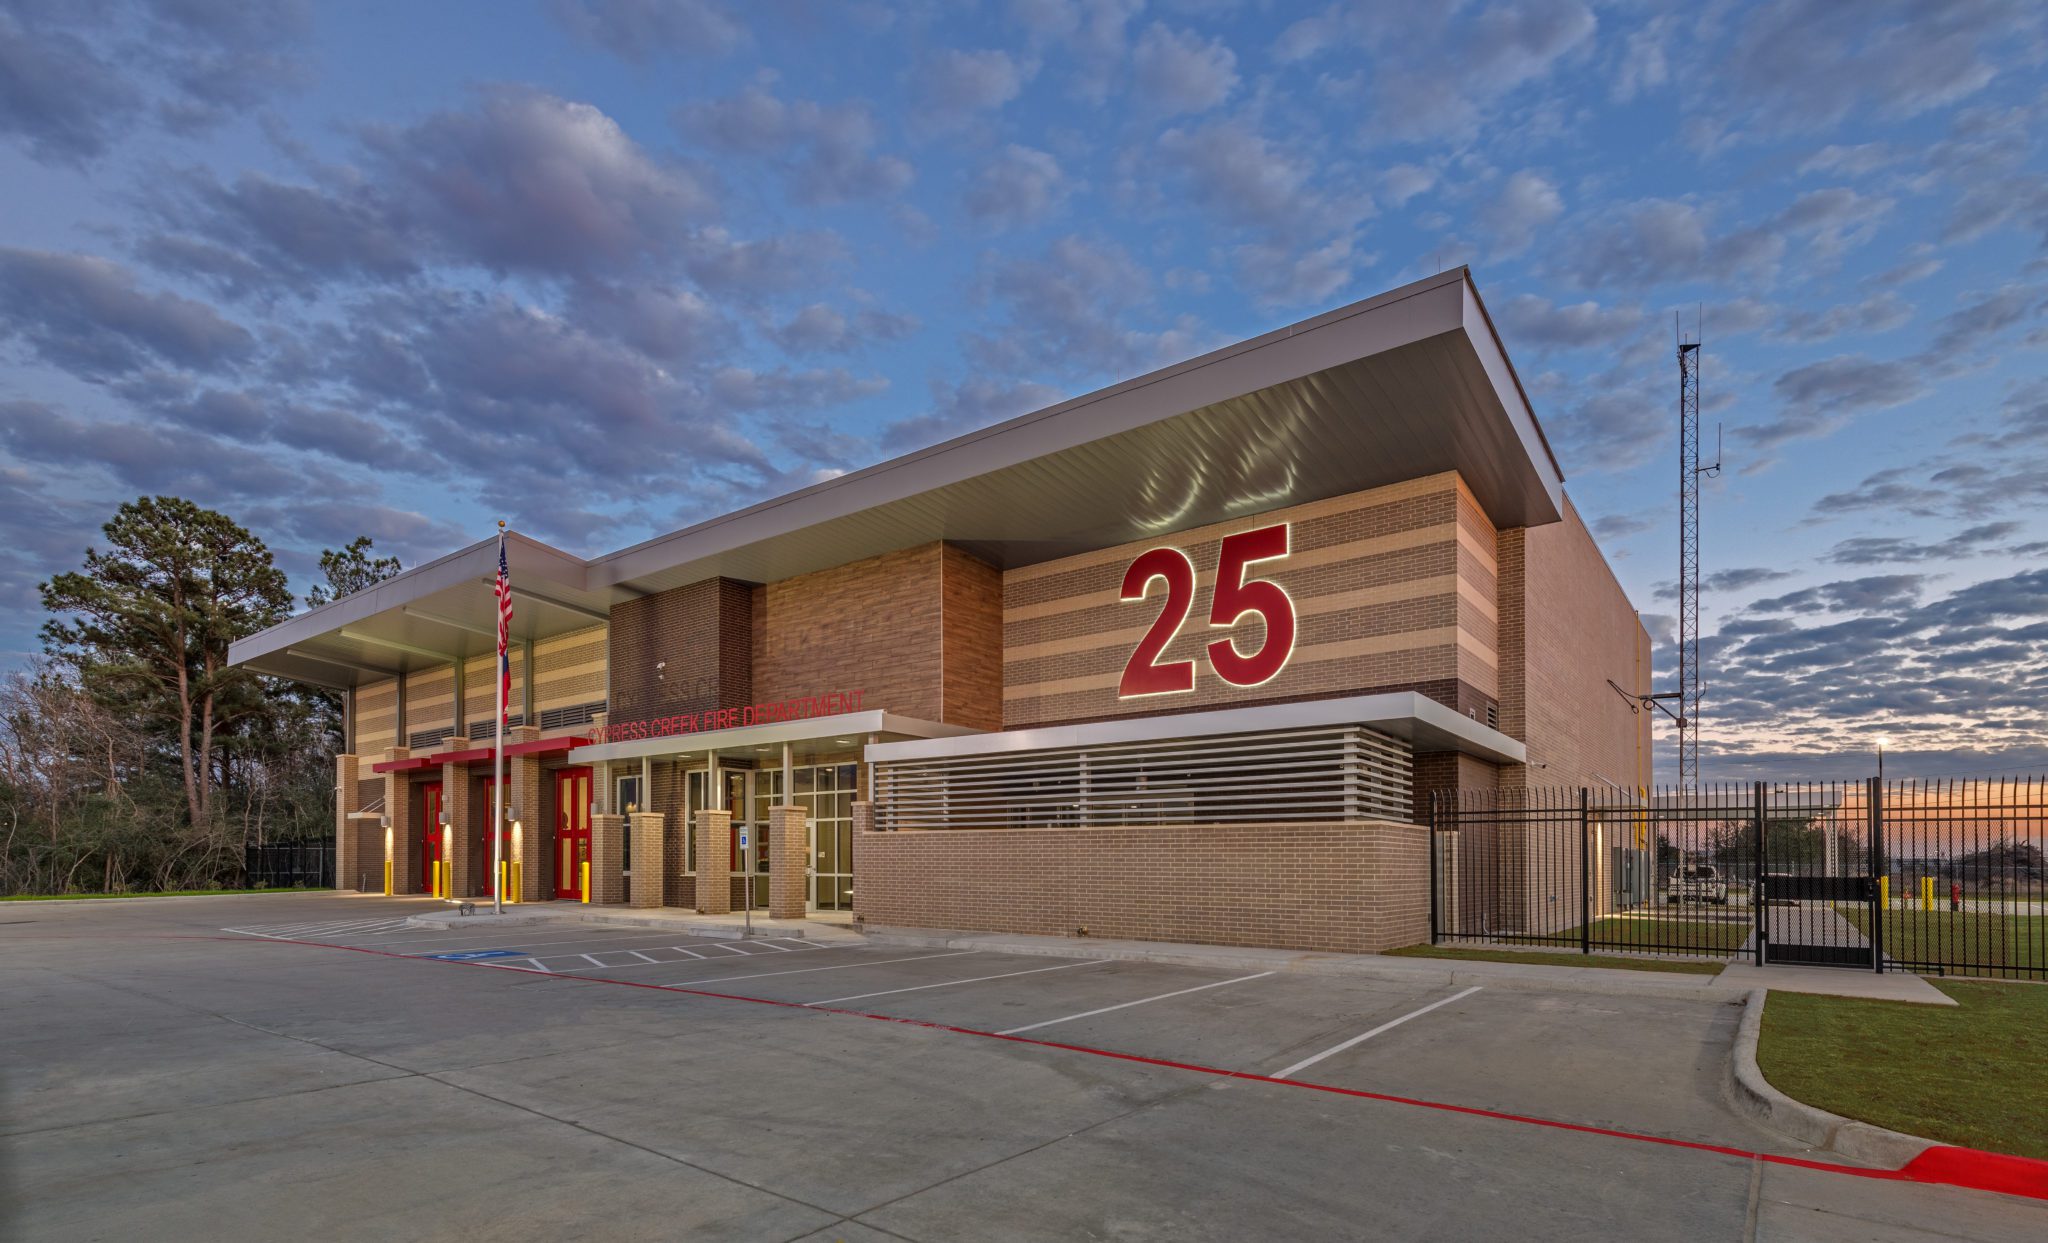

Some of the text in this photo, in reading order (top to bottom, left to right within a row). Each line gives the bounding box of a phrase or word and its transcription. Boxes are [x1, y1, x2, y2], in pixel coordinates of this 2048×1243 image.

[1118, 522, 1297, 699] 25
[588, 688, 865, 746] CYPRESS CREEK FIRE DEPARTMENT
